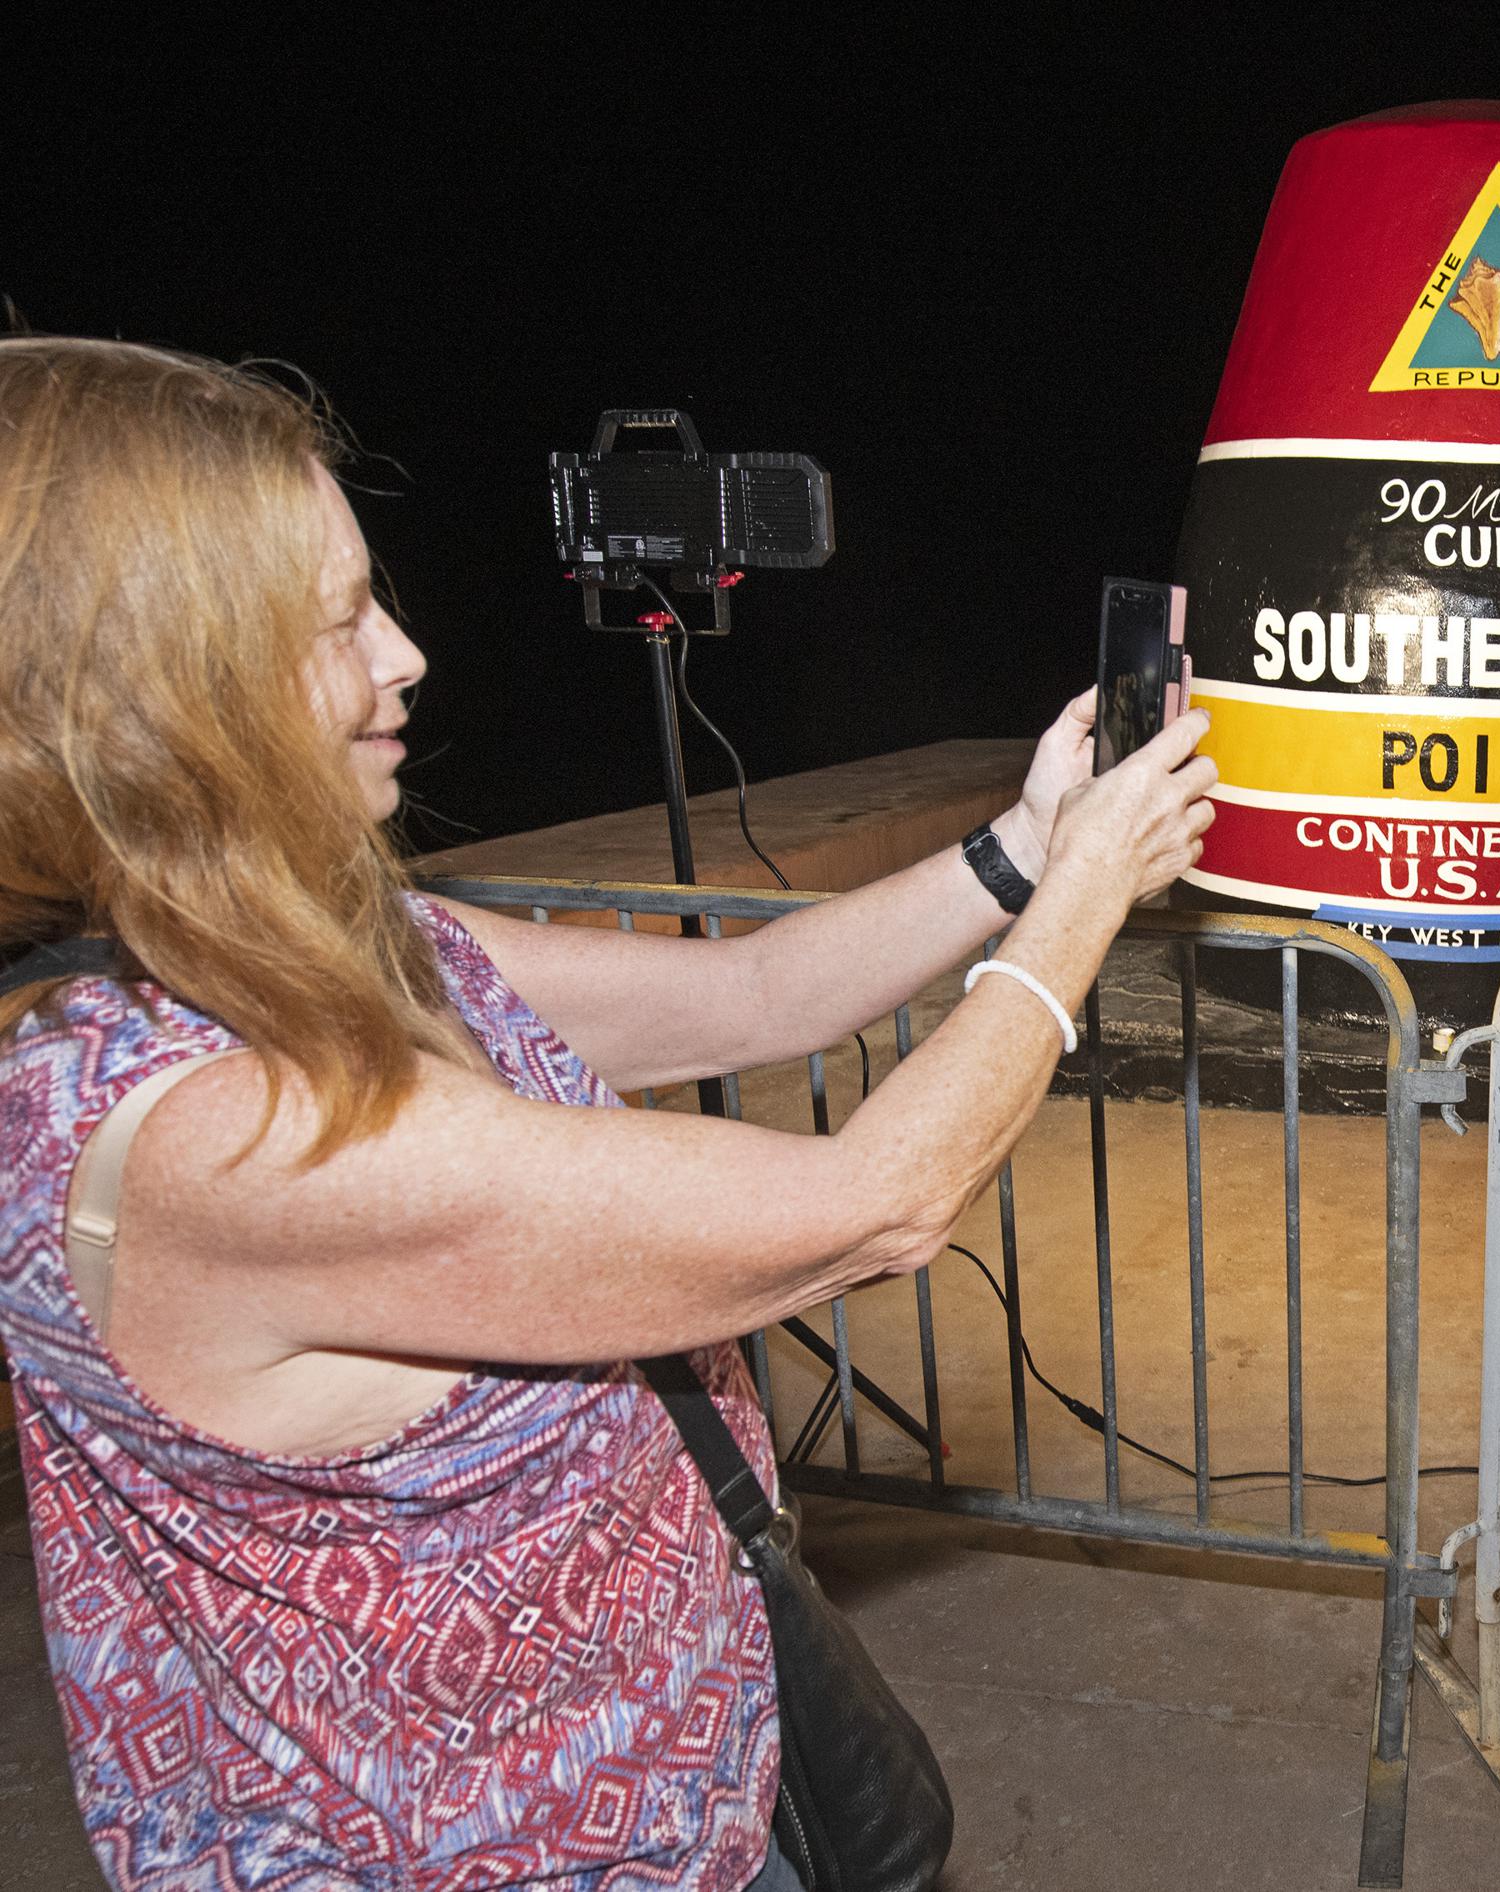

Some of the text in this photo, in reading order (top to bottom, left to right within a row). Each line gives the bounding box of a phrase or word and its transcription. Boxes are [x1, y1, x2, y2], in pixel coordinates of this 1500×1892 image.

[1419, 252, 1462, 311] THE
[1380, 478, 1448, 523] 90
[1347, 920, 1393, 945] KEY
[1410, 927, 1486, 949] WEST
